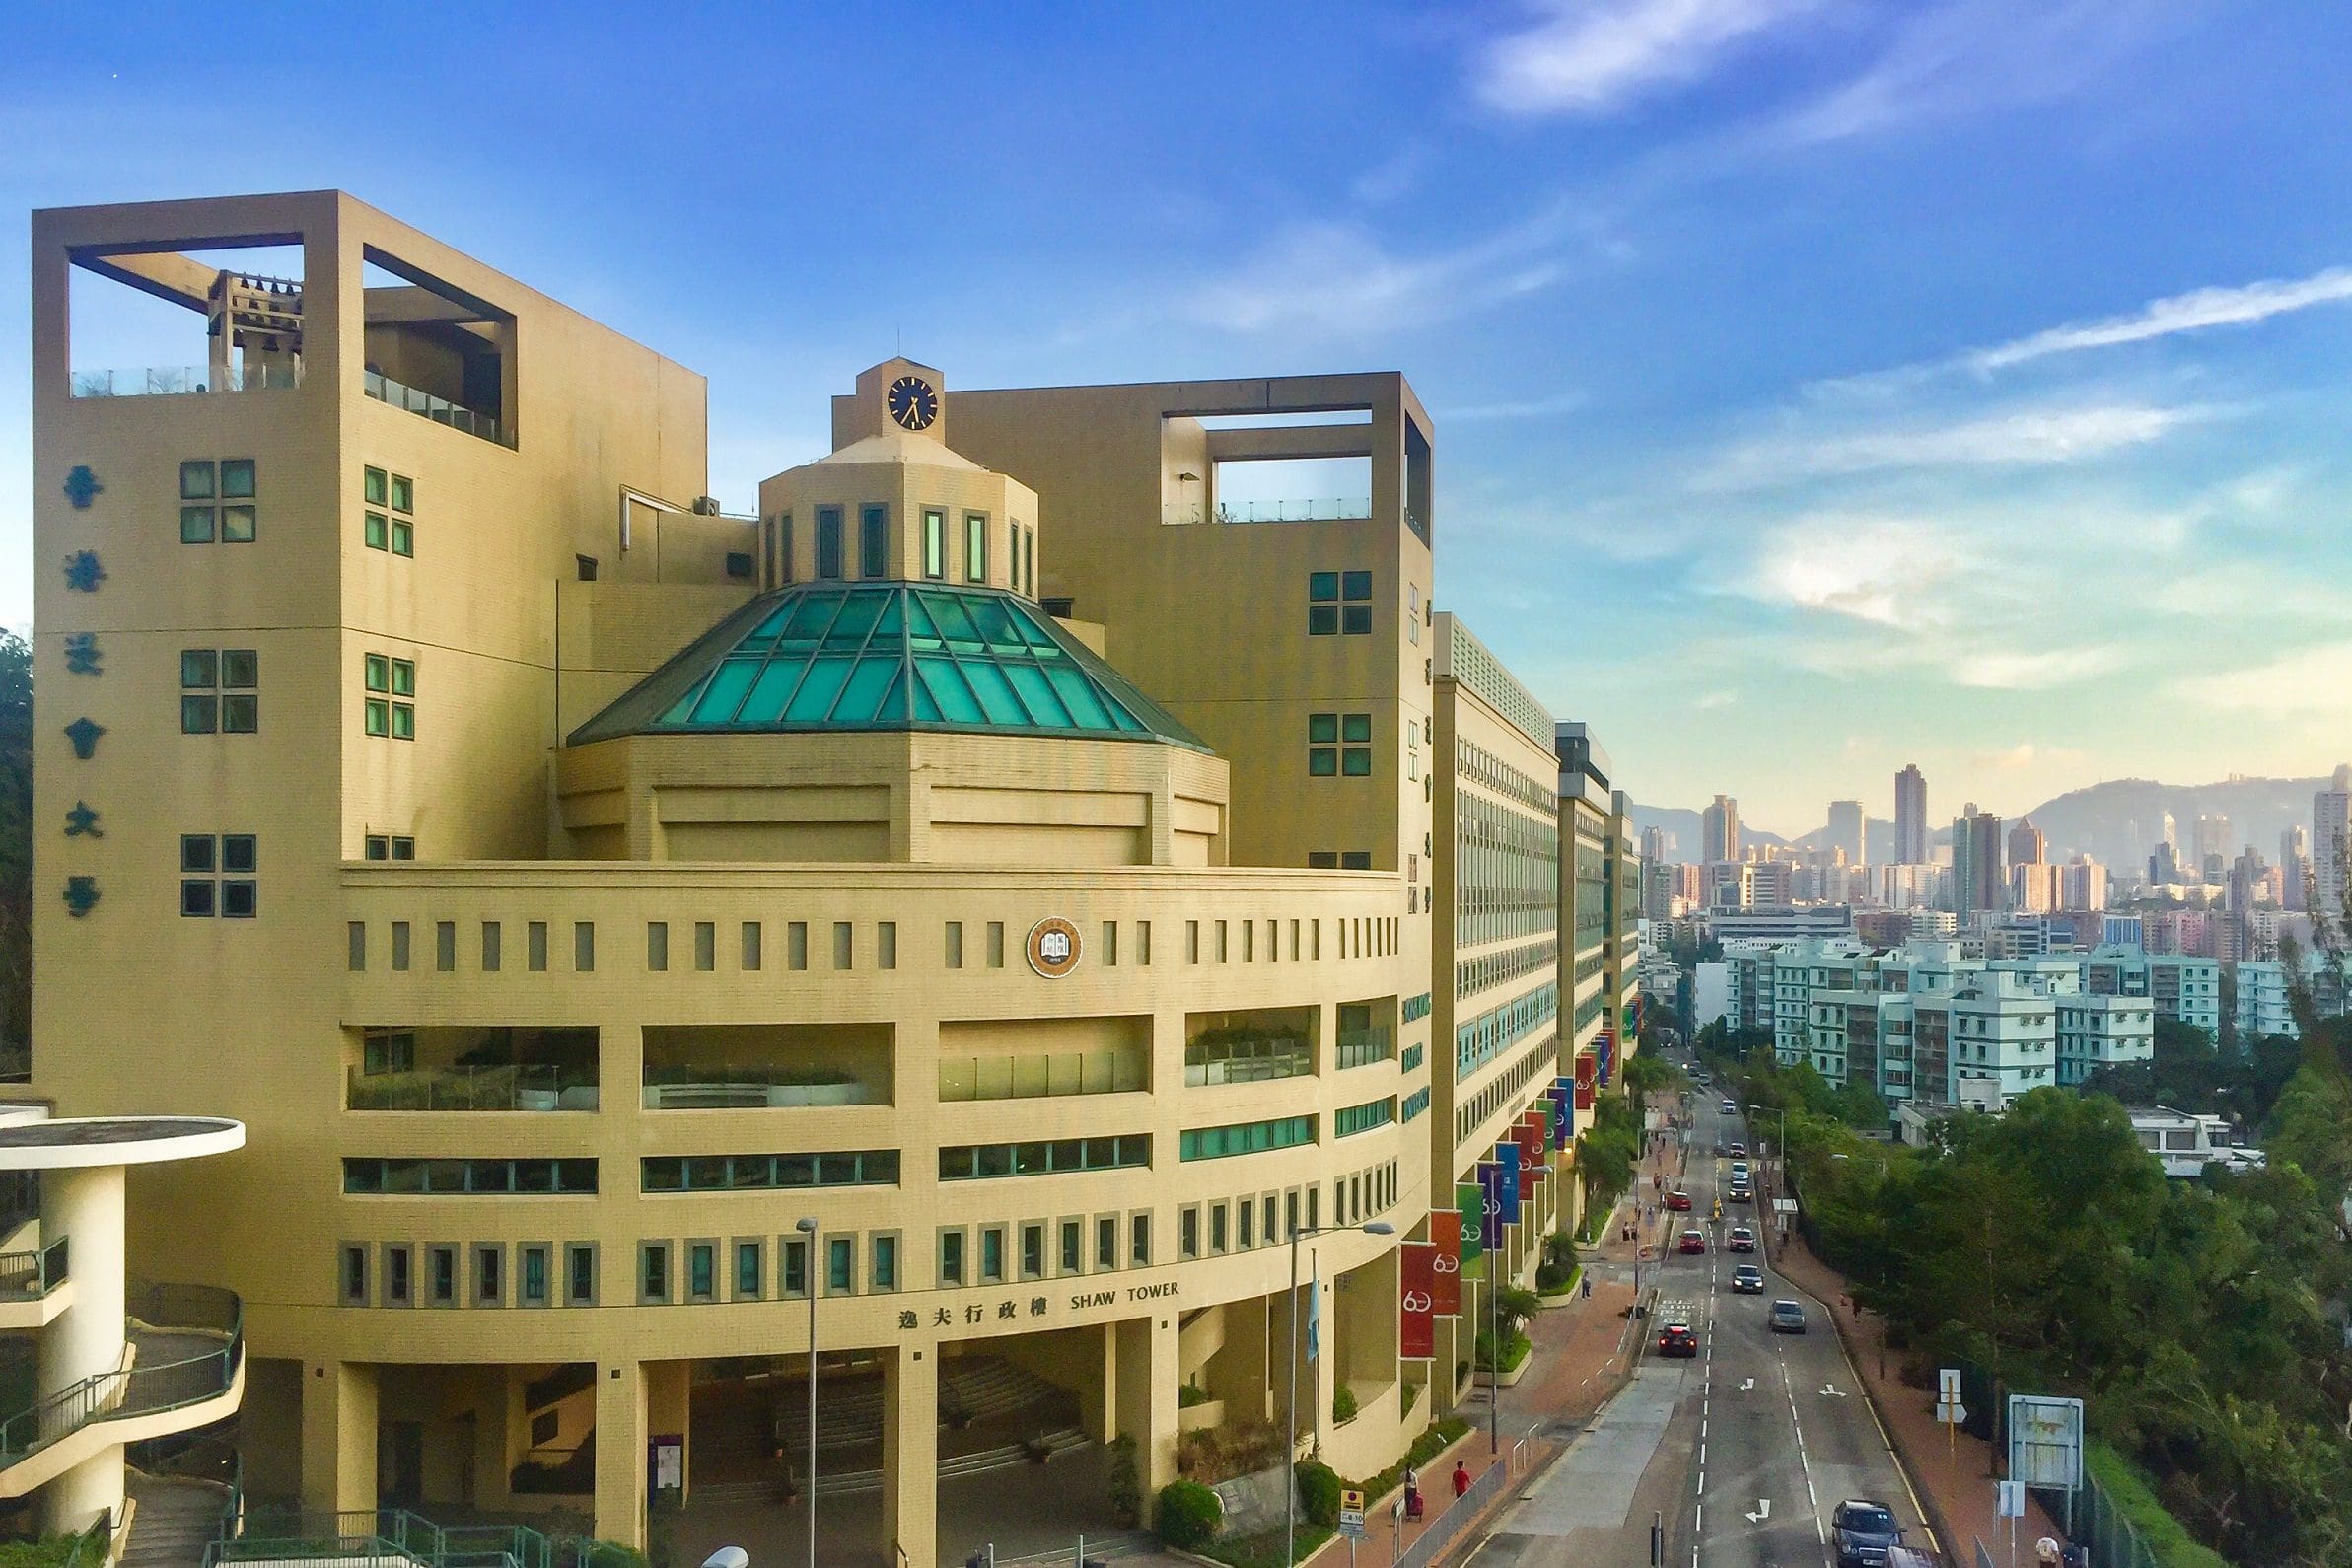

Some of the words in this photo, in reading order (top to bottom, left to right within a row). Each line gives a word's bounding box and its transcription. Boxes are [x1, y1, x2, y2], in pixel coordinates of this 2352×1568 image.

[1461, 1224, 1481, 1241] 60
[1433, 1253, 1459, 1273] 60
[1071, 1291, 1116, 1310] SHAW
[1127, 1282, 1179, 1302] TOWER
[1403, 1290, 1432, 1313] 60
